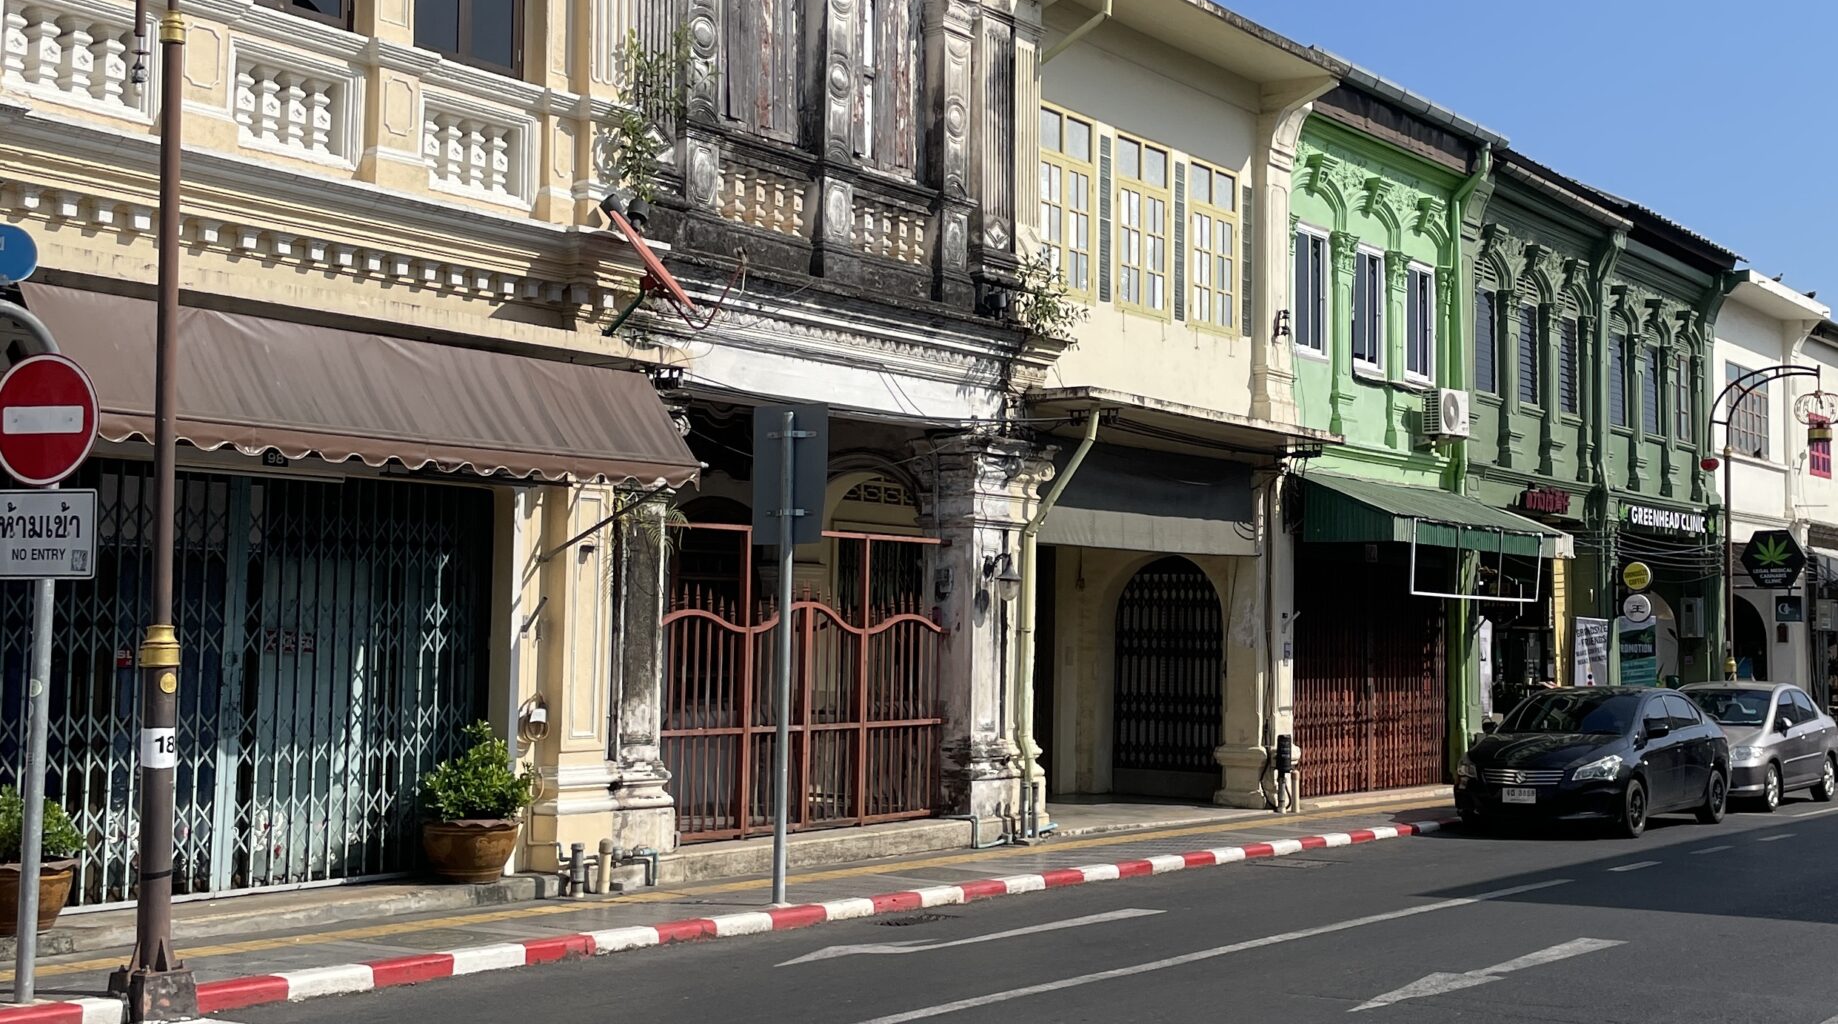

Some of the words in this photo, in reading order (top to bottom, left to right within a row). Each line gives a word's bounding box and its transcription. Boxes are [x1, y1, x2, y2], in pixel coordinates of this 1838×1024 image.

[267, 452, 284, 464] 98
[0, 501, 81, 539] ห้ามเข้า
[1631, 506, 1680, 529] GREENHEAD
[1681, 513, 1706, 533] CLINIC
[11, 548, 27, 561] NO
[31, 548, 66, 561] ENTRY
[1620, 643, 1653, 653] ROMOTION
